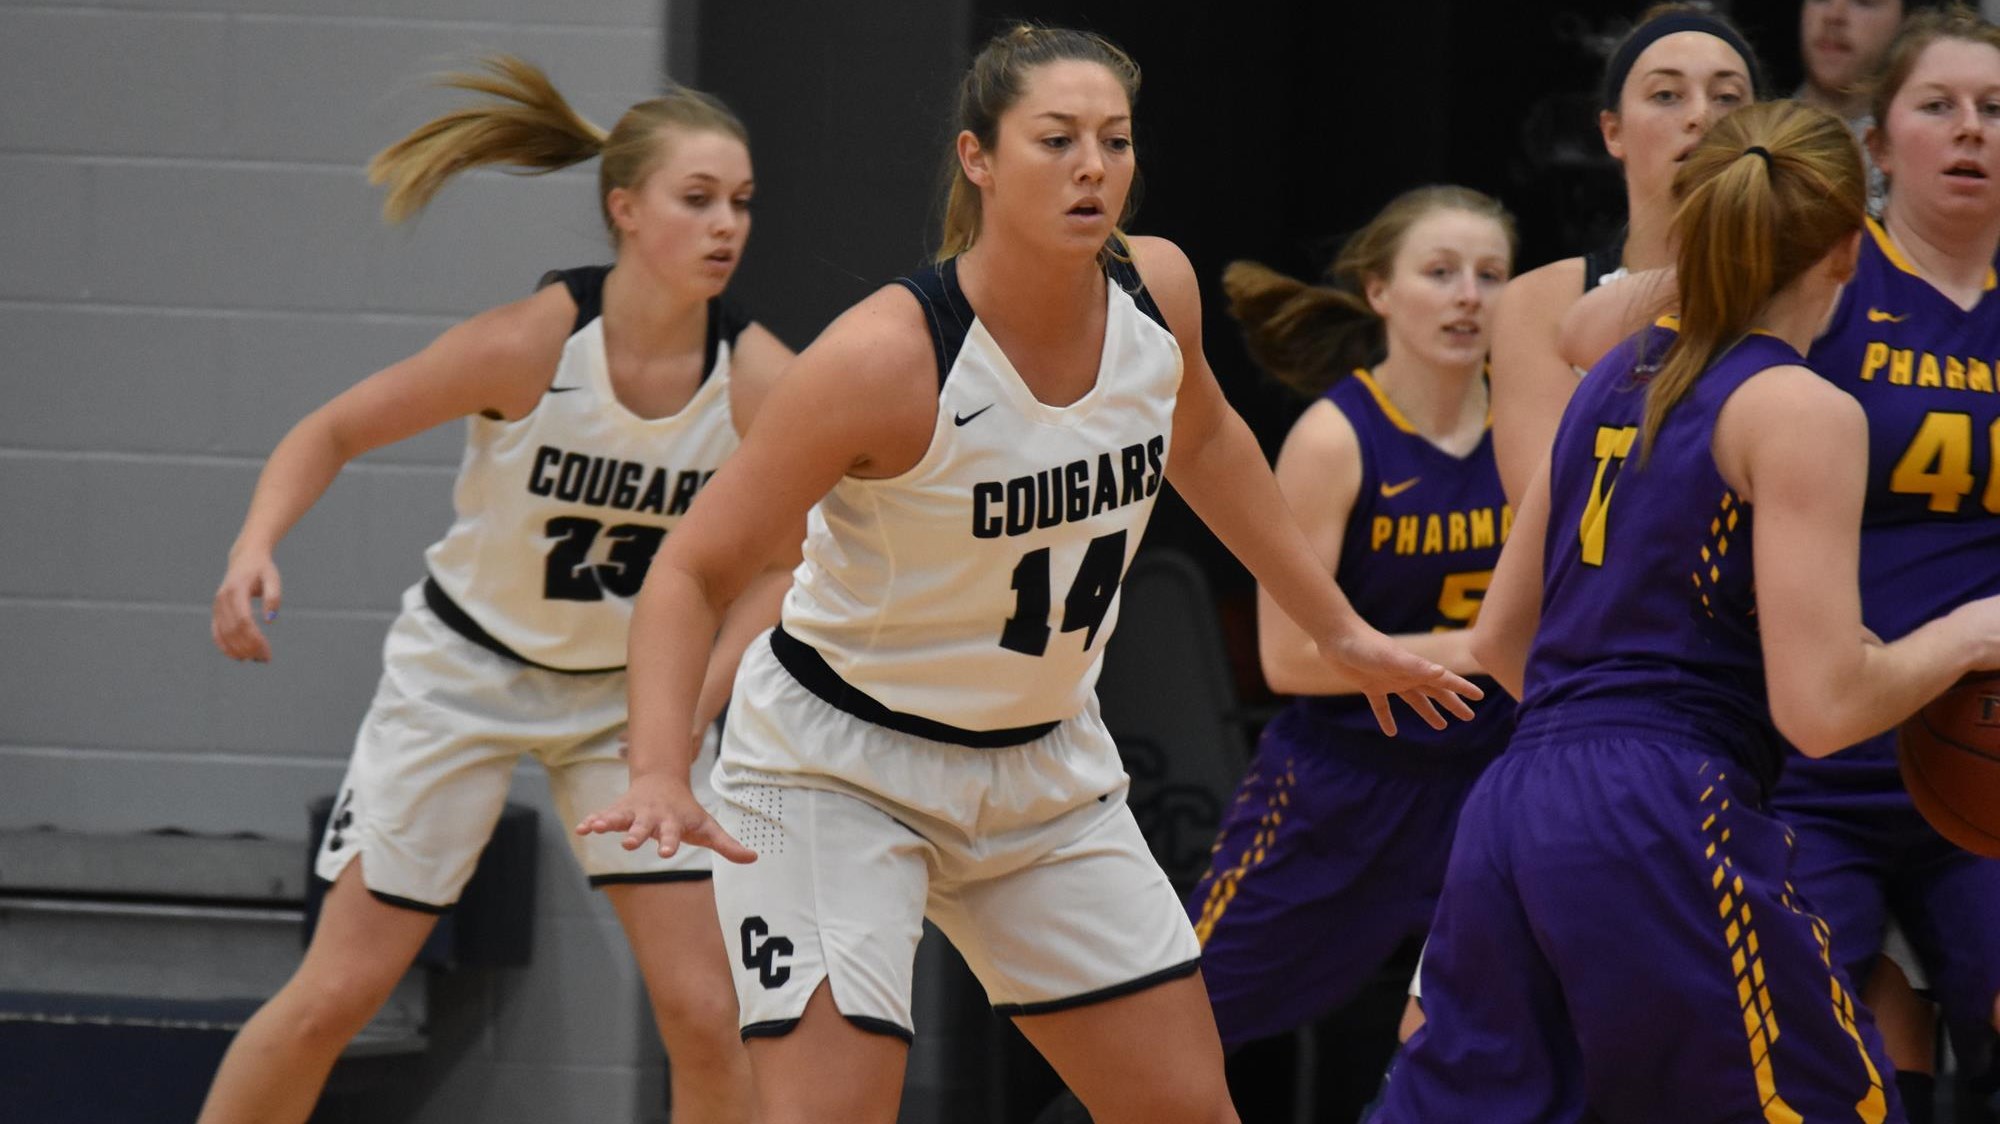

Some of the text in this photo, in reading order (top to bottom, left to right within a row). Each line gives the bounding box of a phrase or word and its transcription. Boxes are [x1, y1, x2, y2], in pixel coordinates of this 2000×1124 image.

[1858, 340, 2000, 394] PHARM
[528, 445, 715, 516] COUGAR
[972, 435, 1165, 538] COUGARS
[543, 515, 668, 601] 23
[999, 529, 1128, 656] 14
[740, 916, 794, 990] CC
